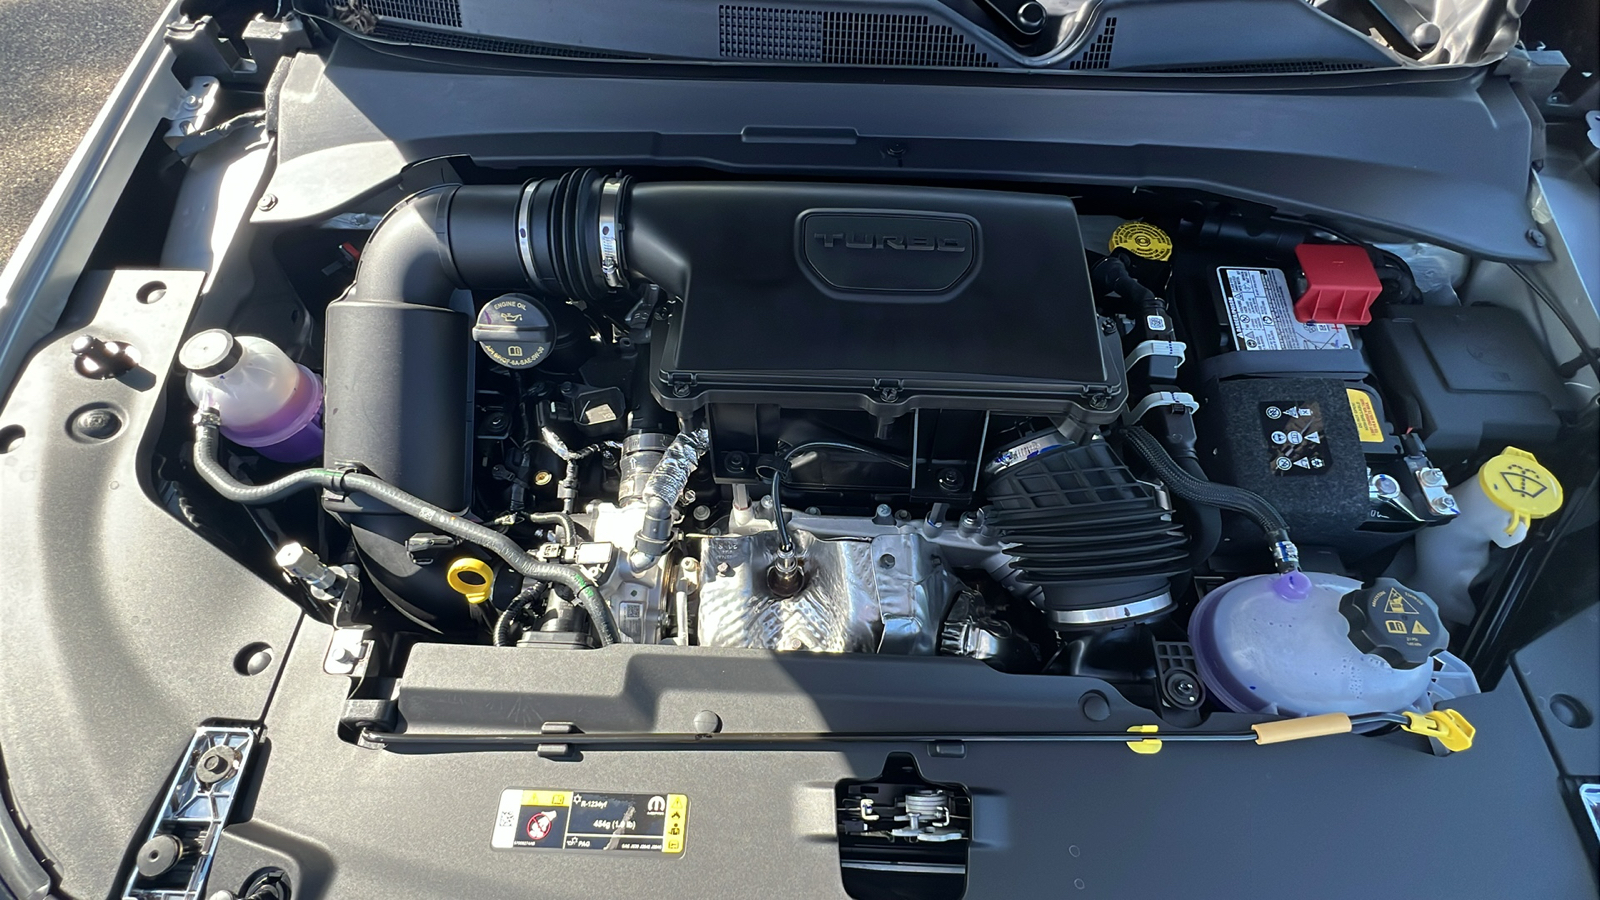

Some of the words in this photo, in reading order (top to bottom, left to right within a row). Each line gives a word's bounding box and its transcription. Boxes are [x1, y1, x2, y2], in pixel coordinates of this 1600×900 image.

[813, 231, 966, 252] TURBO
[494, 301, 516, 310] ENGINE
[517, 303, 527, 311] OIL
[580, 799, 608, 810] R-1234yf
[593, 819, 611, 831] 454g
[577, 840, 591, 848] PAG
